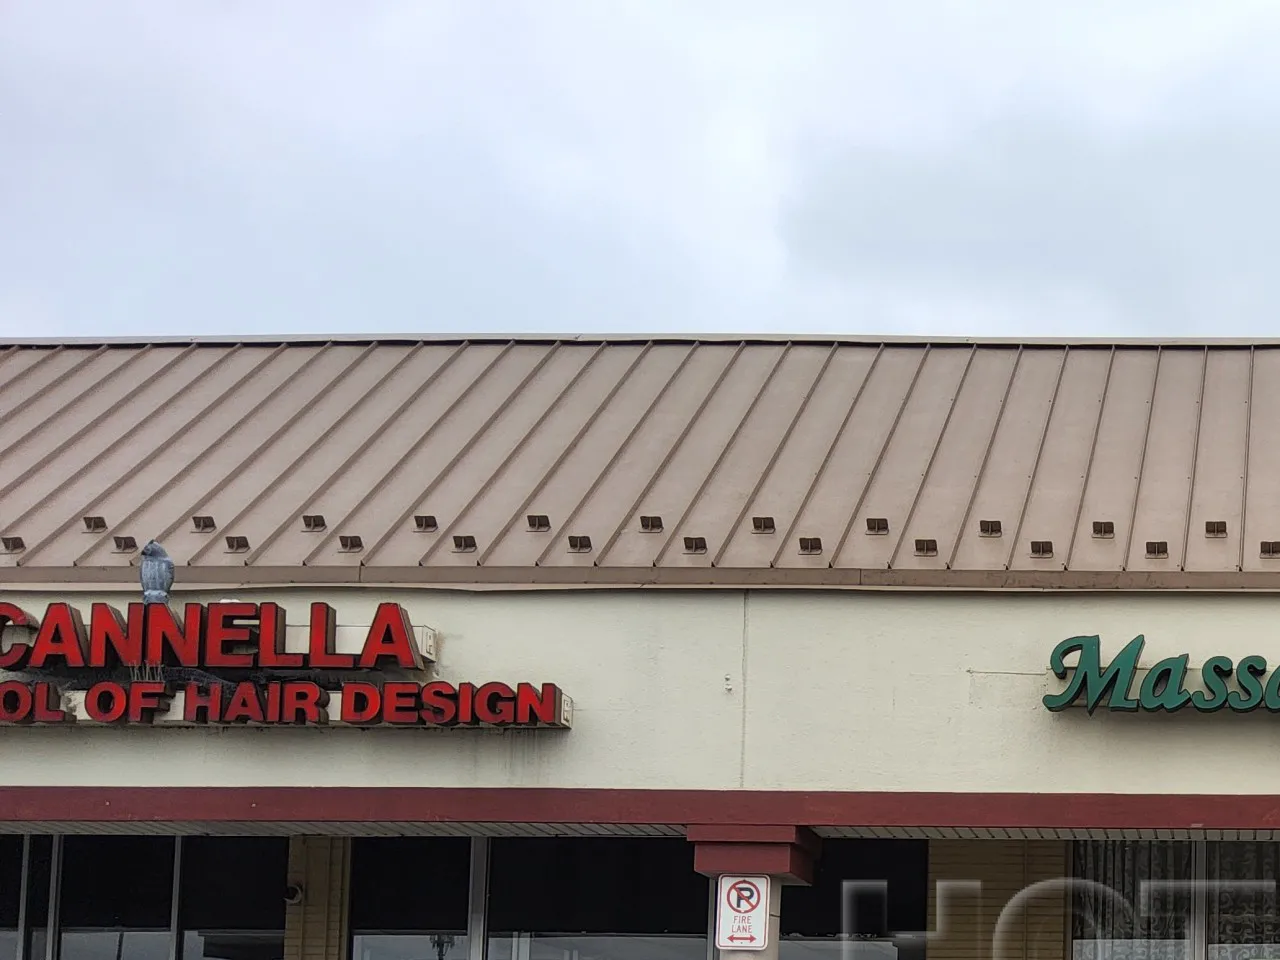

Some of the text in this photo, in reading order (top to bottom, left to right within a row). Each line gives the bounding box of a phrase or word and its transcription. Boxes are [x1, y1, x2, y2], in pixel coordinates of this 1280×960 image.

[85, 681, 166, 723] OF
[184, 680, 326, 724] HAIR
[341, 681, 557, 725] DESIGN
[734, 915, 753, 925] FIRE
[732, 924, 753, 934] LANE
